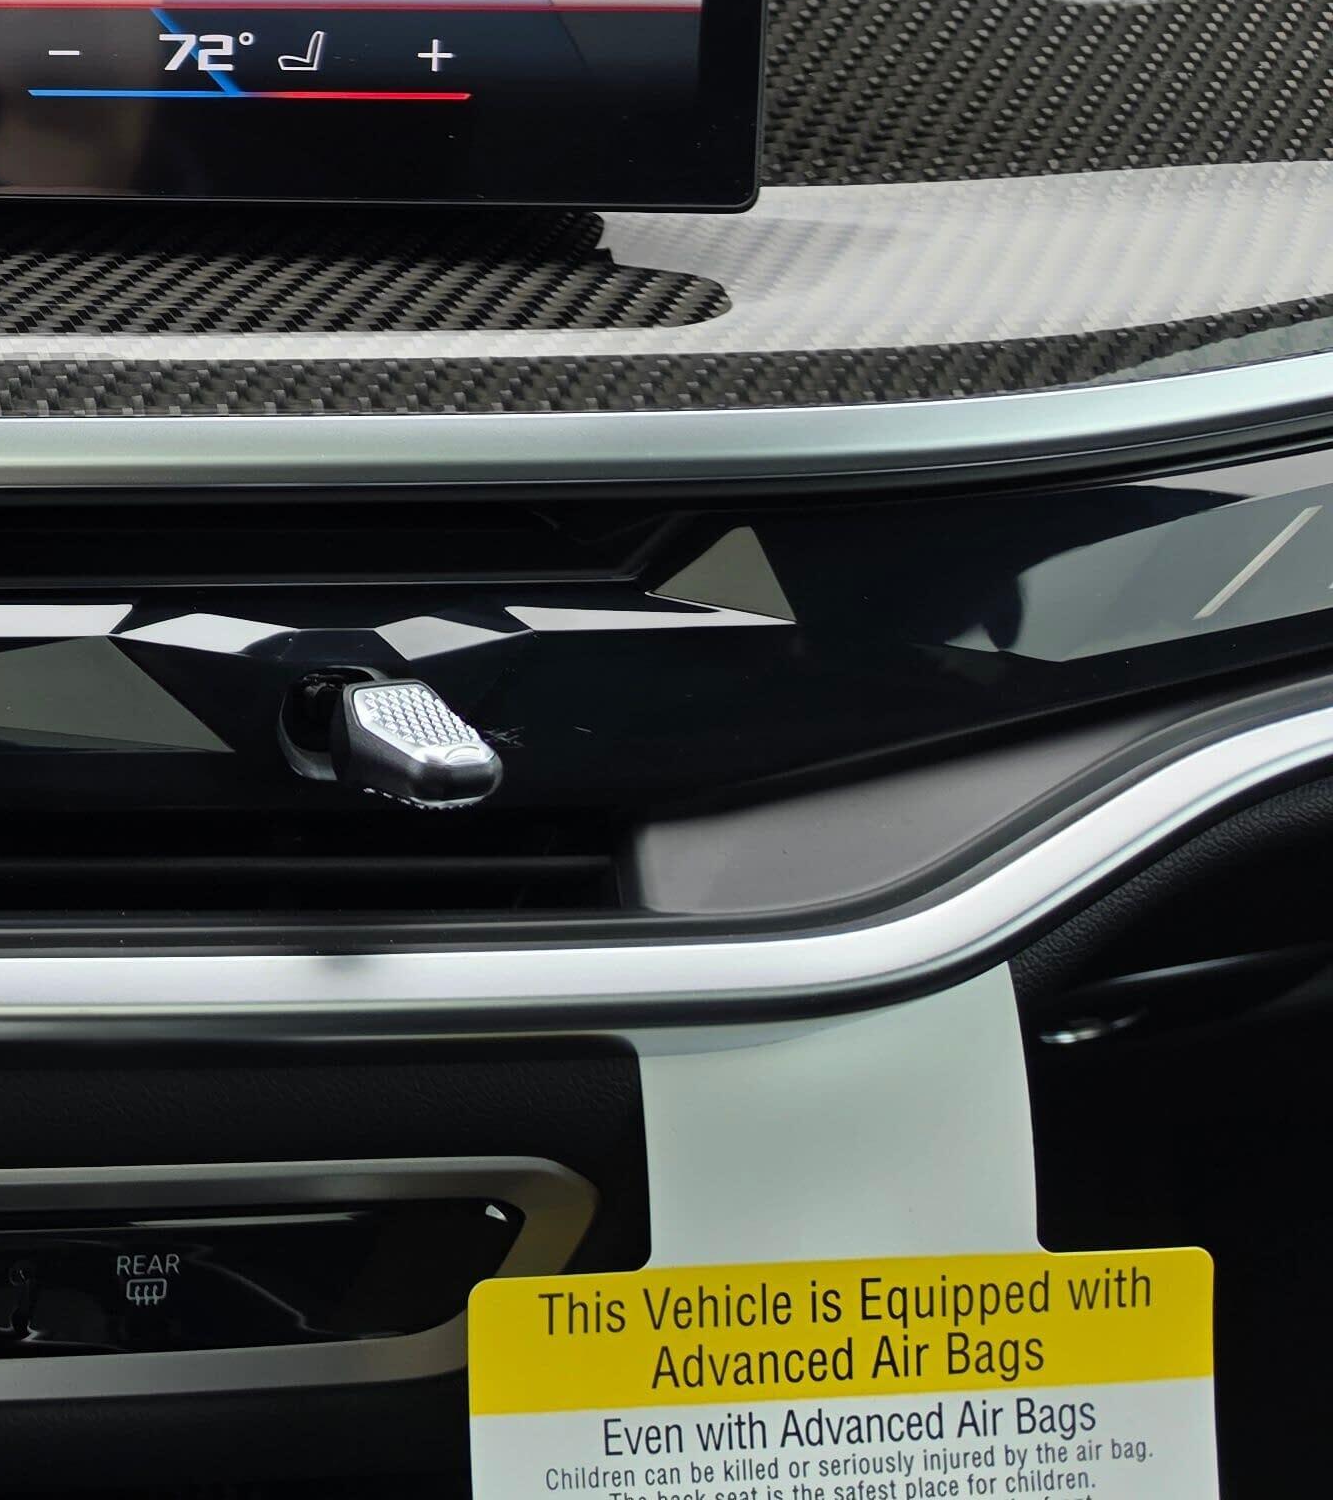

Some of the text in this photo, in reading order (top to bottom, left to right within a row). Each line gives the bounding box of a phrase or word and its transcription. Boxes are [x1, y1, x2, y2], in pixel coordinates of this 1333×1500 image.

[116, 1254, 180, 1276] REAR
[538, 1266, 1151, 1335] This Vehicle is Equipped with
[651, 1332, 1045, 1389] Advanced Air Bags
[603, 1397, 1097, 1456] Even with Advanced Air Bags
[545, 1438, 1154, 1491] Children can be killed or seriously injured by the air bag.
[792, 1483, 825, 1500] the
[833, 1480, 896, 1500] safest
[905, 1476, 960, 1500] place
[967, 1473, 997, 1496] for
[1005, 1469, 1097, 1493] children.
